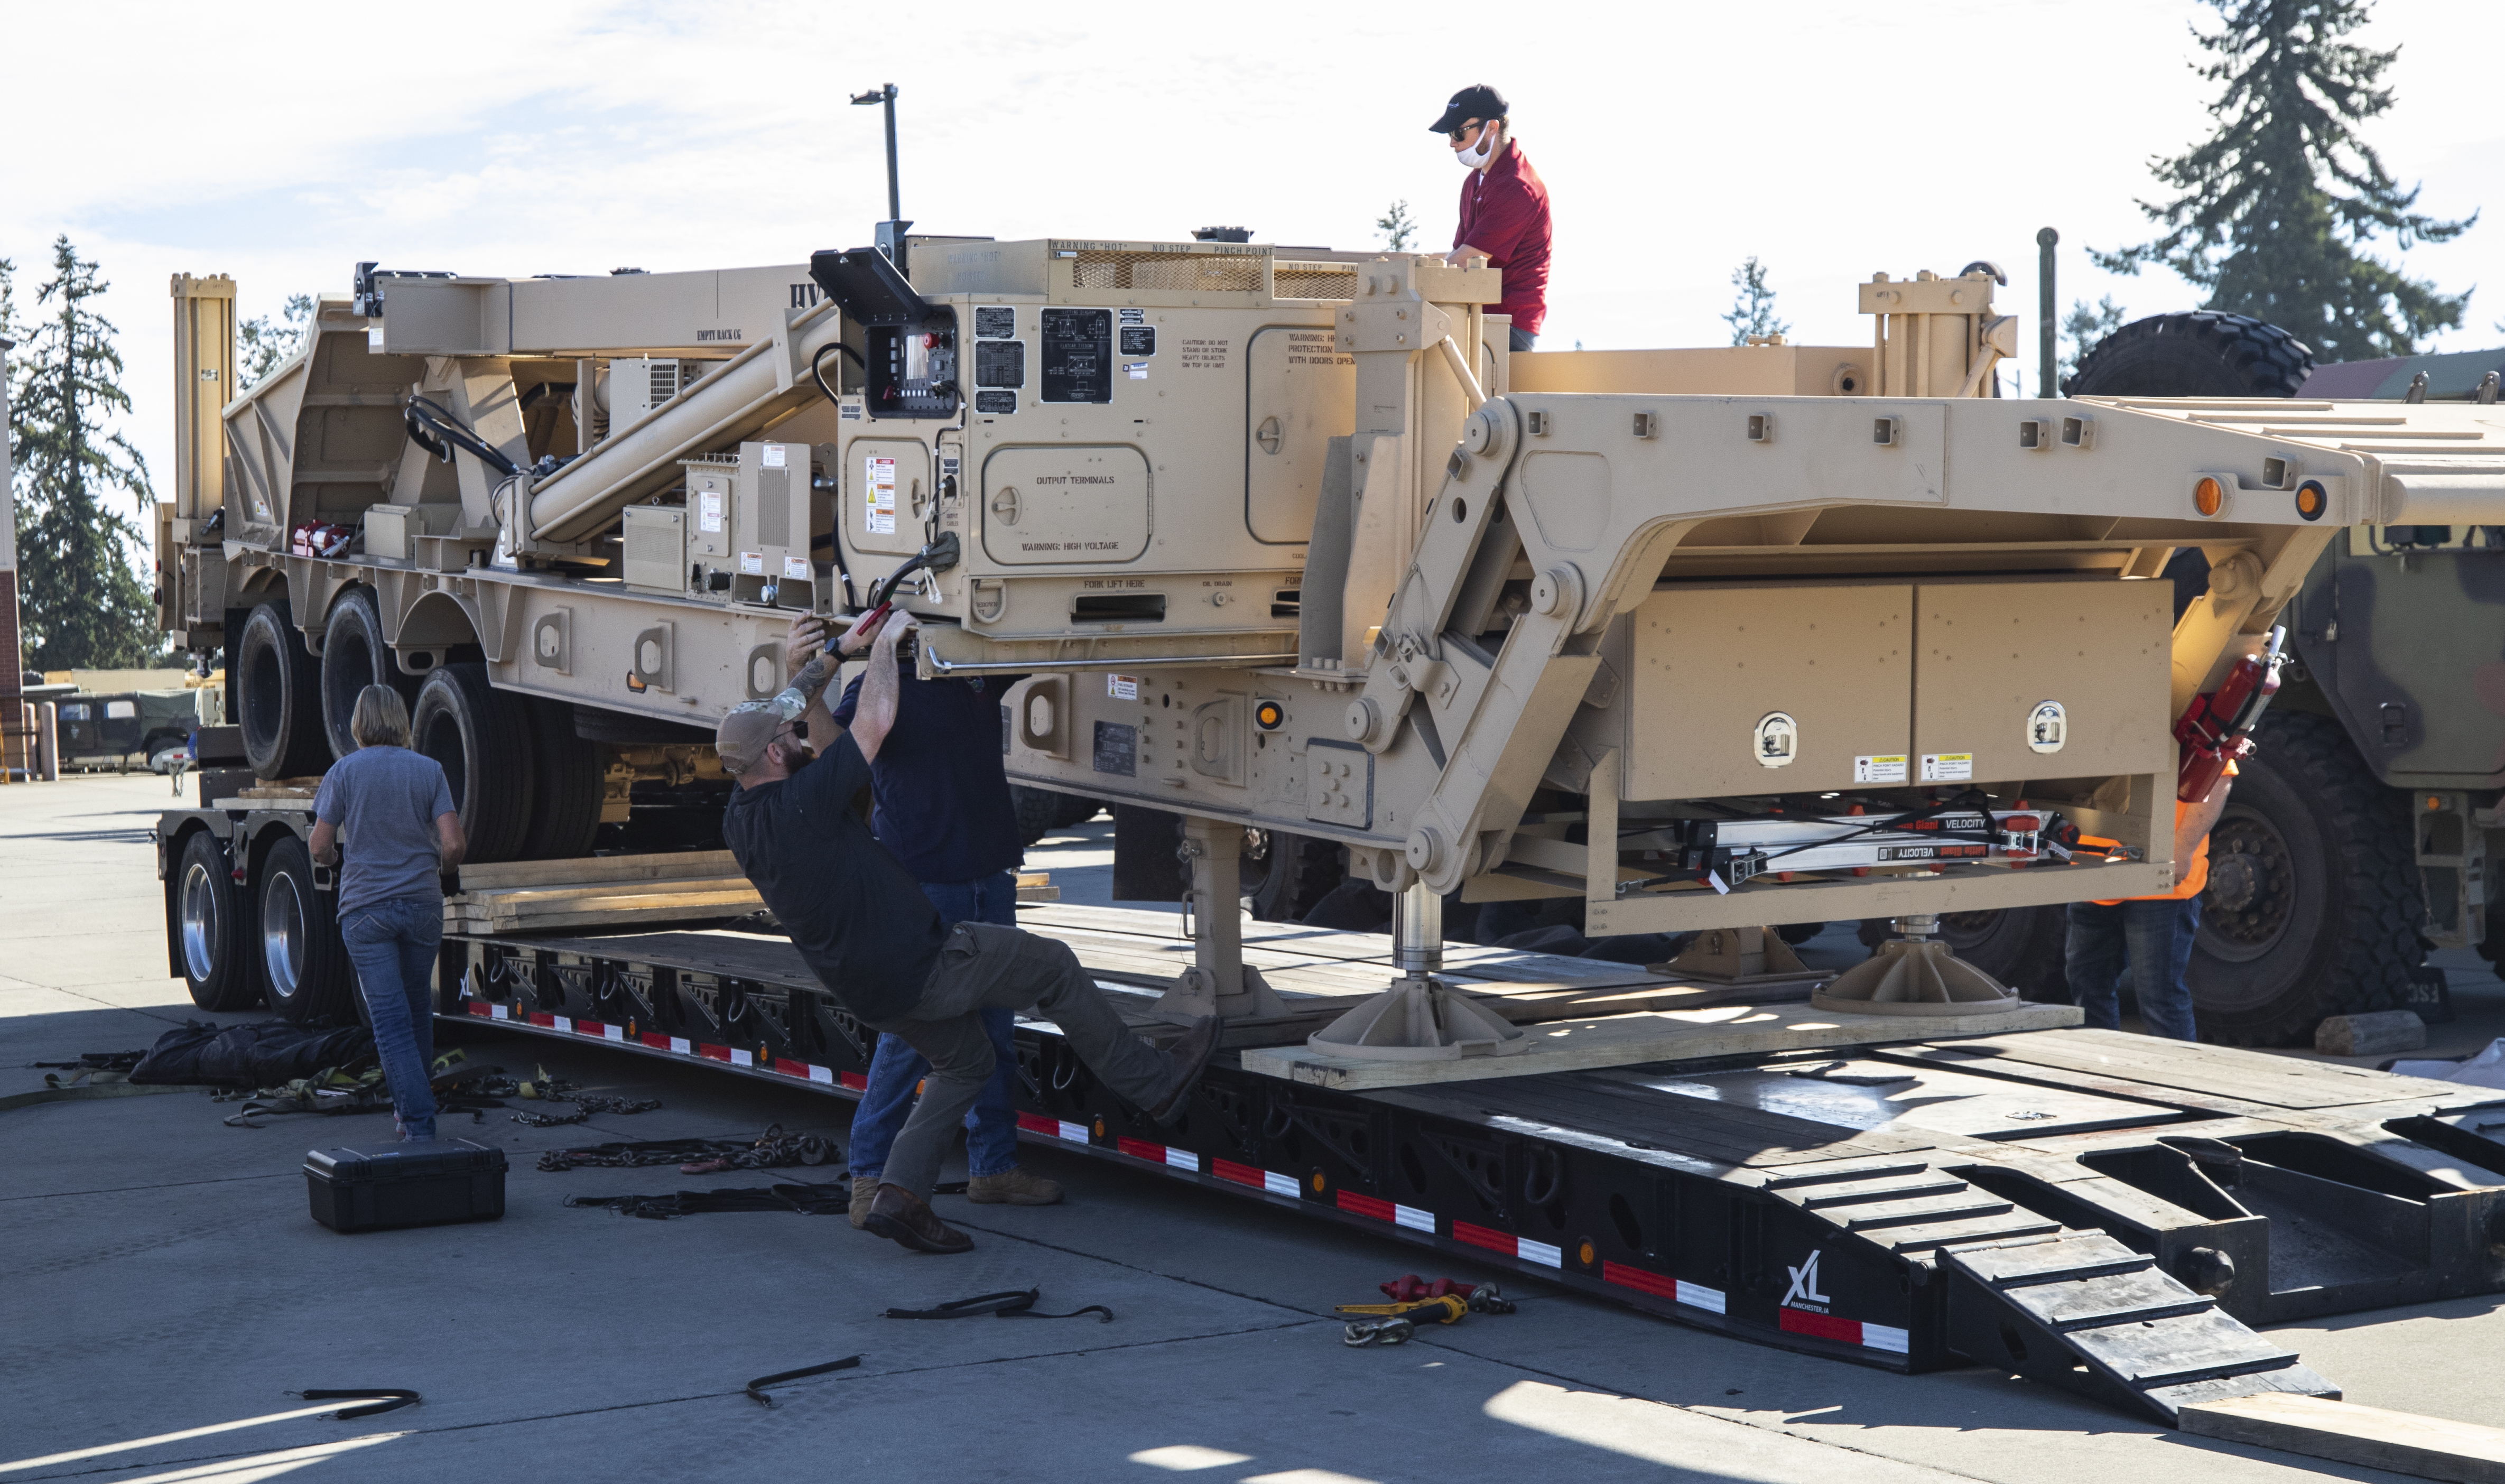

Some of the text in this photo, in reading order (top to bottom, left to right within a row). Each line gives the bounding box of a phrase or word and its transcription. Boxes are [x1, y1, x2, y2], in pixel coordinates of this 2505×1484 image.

[1052, 240, 1096, 250] WARNING
[1214, 246, 1242, 255] PINCH
[1246, 247, 1273, 256] POINT
[790, 283, 829, 308] HV
[697, 329, 741, 341] EMPTY RACK CG
[1288, 333, 1324, 342] WARNING:
[1288, 345, 1333, 353] PROTECTION
[1288, 356, 1306, 364] WITH
[1070, 476, 1115, 484] TERMINALS
[1022, 542, 1118, 551] WARNING: HIGH VOLTAGE
[1126, 579, 1145, 588] HERE
[1915, 820, 1938, 830] Giant
[1946, 819, 1986, 829] VELOCITY
[1898, 847, 1934, 858] VELOCITY
[459, 968, 473, 1000] XL
[1781, 1249, 1830, 1306] XL
[1790, 1301, 1823, 1313] MANCHESTER,
